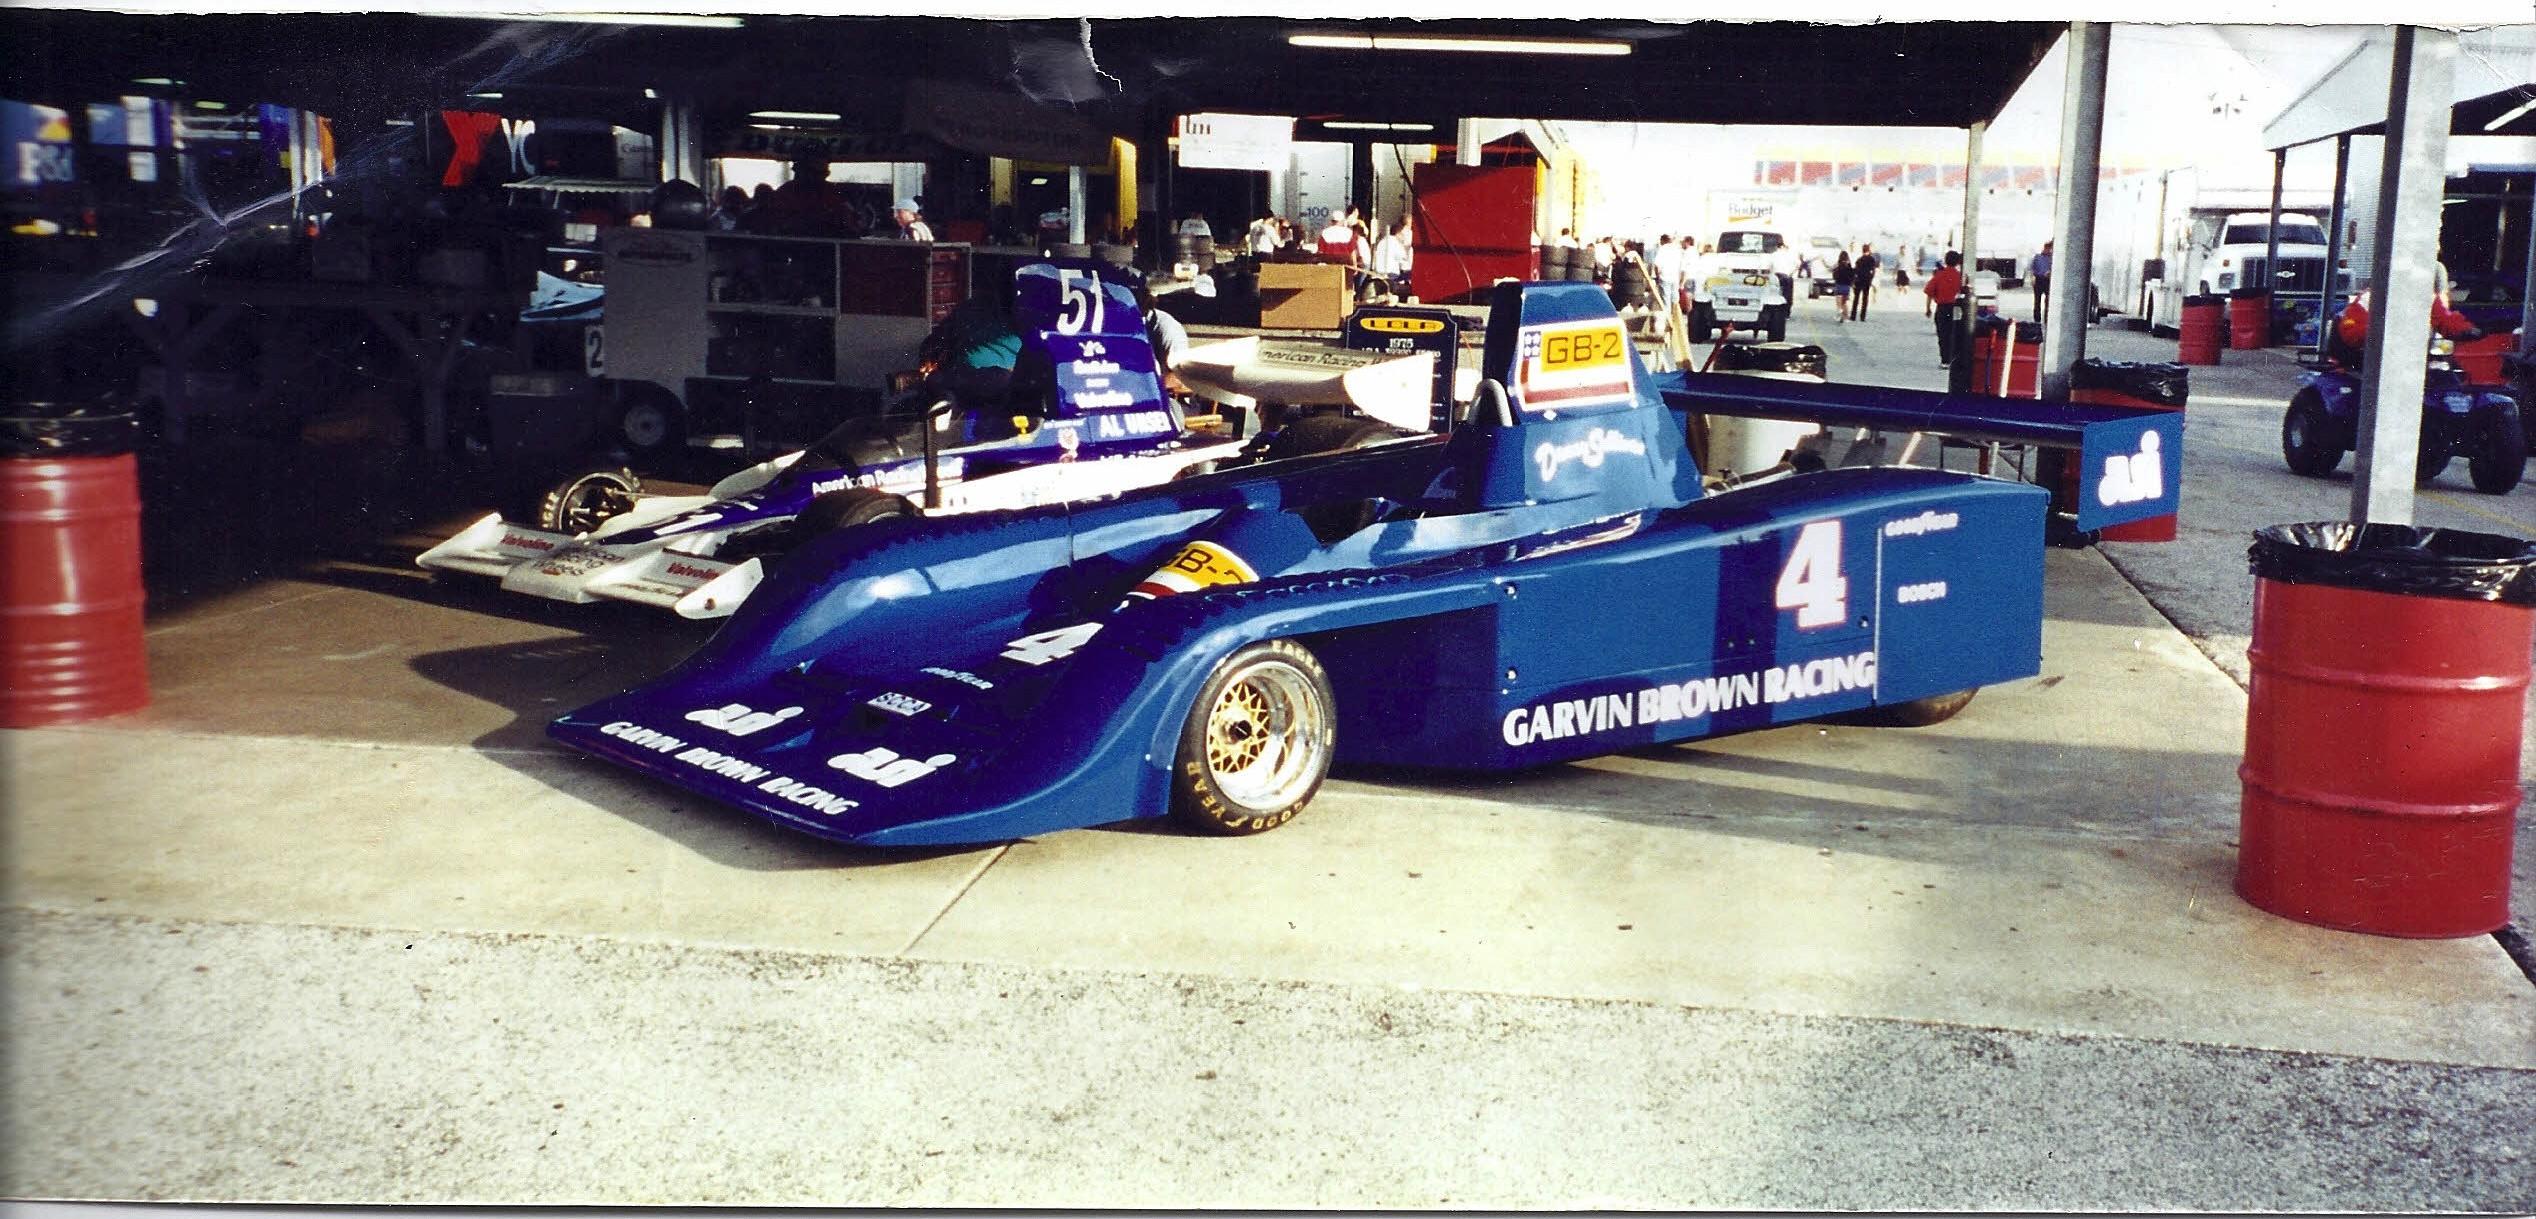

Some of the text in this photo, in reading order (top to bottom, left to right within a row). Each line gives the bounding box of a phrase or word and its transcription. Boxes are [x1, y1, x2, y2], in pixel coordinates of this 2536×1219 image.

[1056, 268, 1105, 336] 51
[1546, 332, 1622, 365] GB-2
[1775, 519, 1848, 630] 4
[1000, 622, 1104, 666] 4
[1502, 651, 1876, 748] GARVIN BROWN RACING
